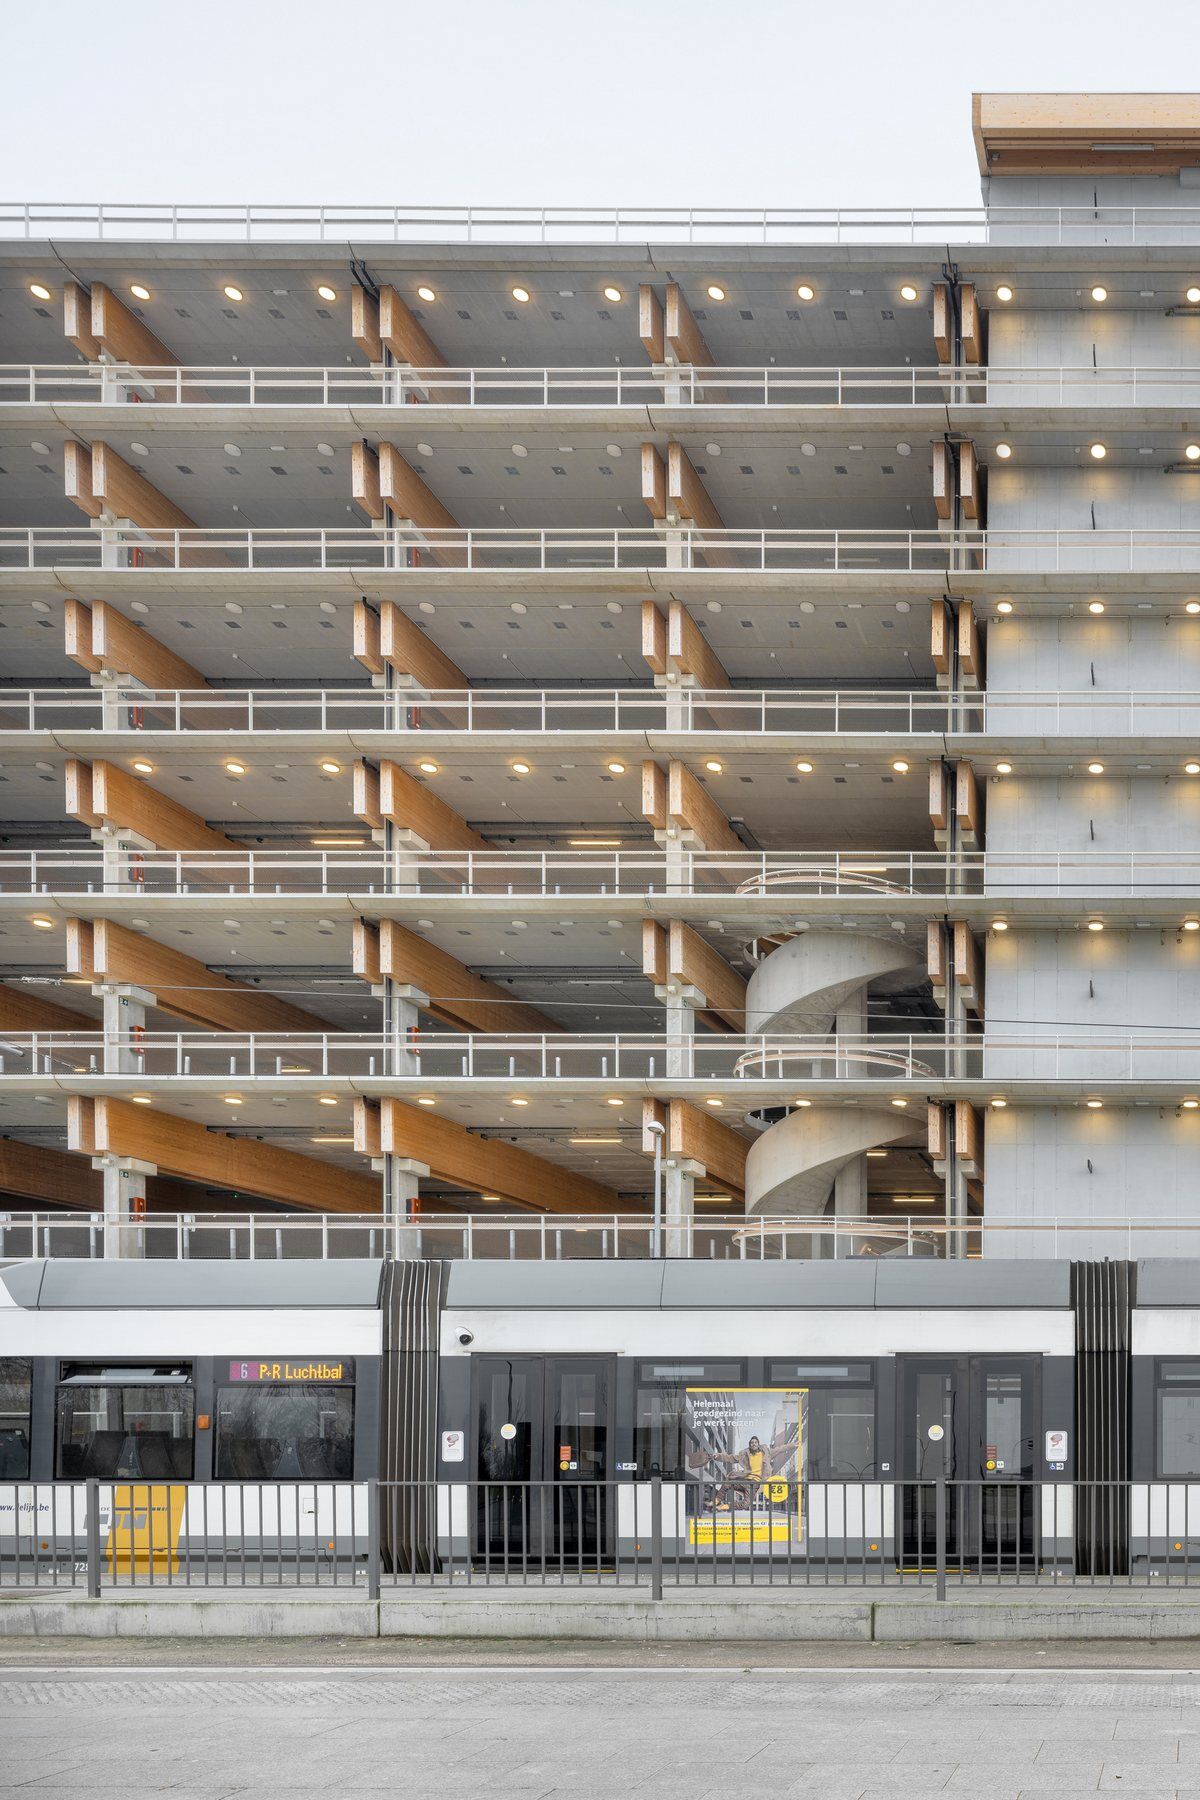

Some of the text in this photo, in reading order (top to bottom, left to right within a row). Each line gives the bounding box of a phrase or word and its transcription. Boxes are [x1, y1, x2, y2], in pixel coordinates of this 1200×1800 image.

[240, 1363, 342, 1379] 6 P+R Luchtbal
[693, 1400, 734, 1408] Helemaal
[693, 1409, 742, 1418] goedgezind
[693, 1419, 701, 1428] je
[703, 1419, 726, 1427] werk
